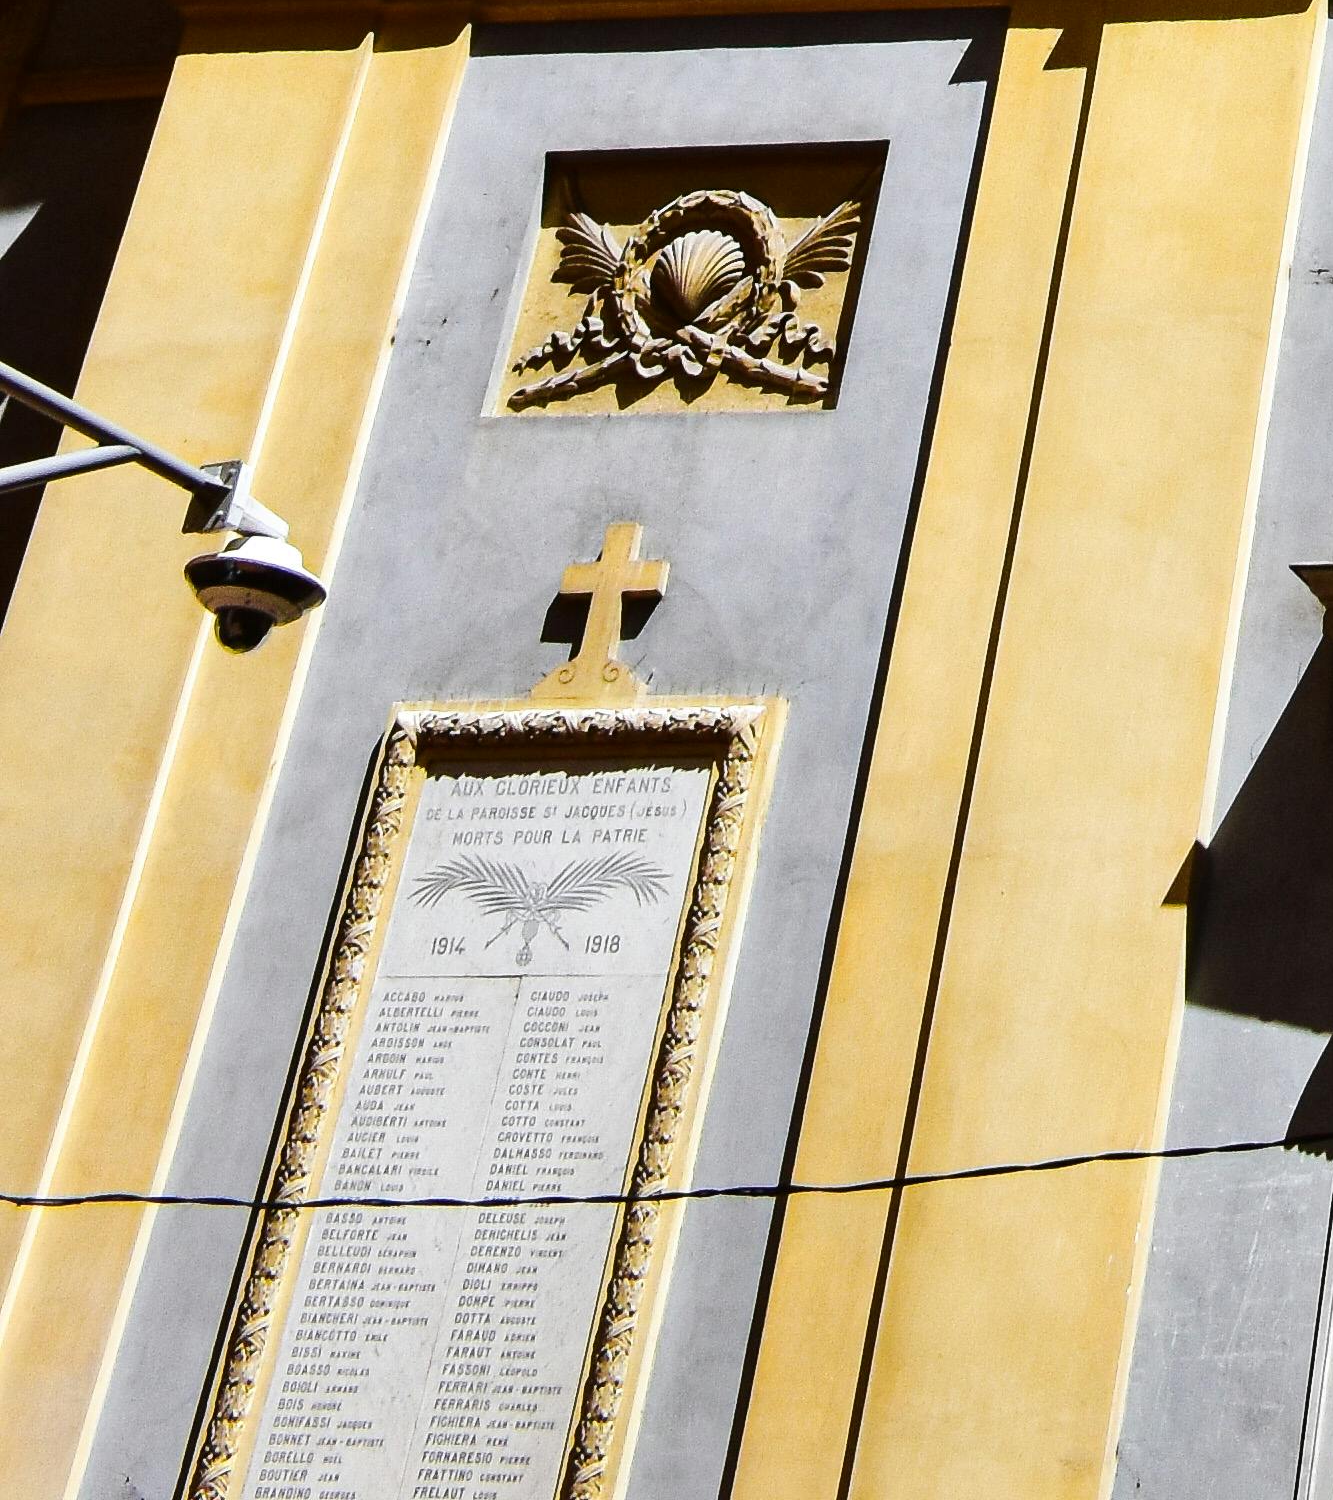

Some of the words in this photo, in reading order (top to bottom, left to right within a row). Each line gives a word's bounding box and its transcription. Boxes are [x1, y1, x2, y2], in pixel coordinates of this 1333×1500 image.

[451, 780, 484, 796] AUX
[496, 778, 580, 796] GLORIEUX
[593, 776, 672, 794] ENFANTS
[426, 807, 441, 820] DE
[447, 807, 464, 820] LA
[470, 806, 536, 820] PAROISSE
[565, 804, 626, 819] JACQUES
[452, 830, 503, 845] MORTS
[513, 829, 553, 844] POUR
[562, 829, 580, 843] LA
[592, 828, 647, 844] PATRIE
[431, 936, 466, 955] 1914
[585, 935, 621, 954] 1918
[359, 1085, 403, 1095] AUBERT
